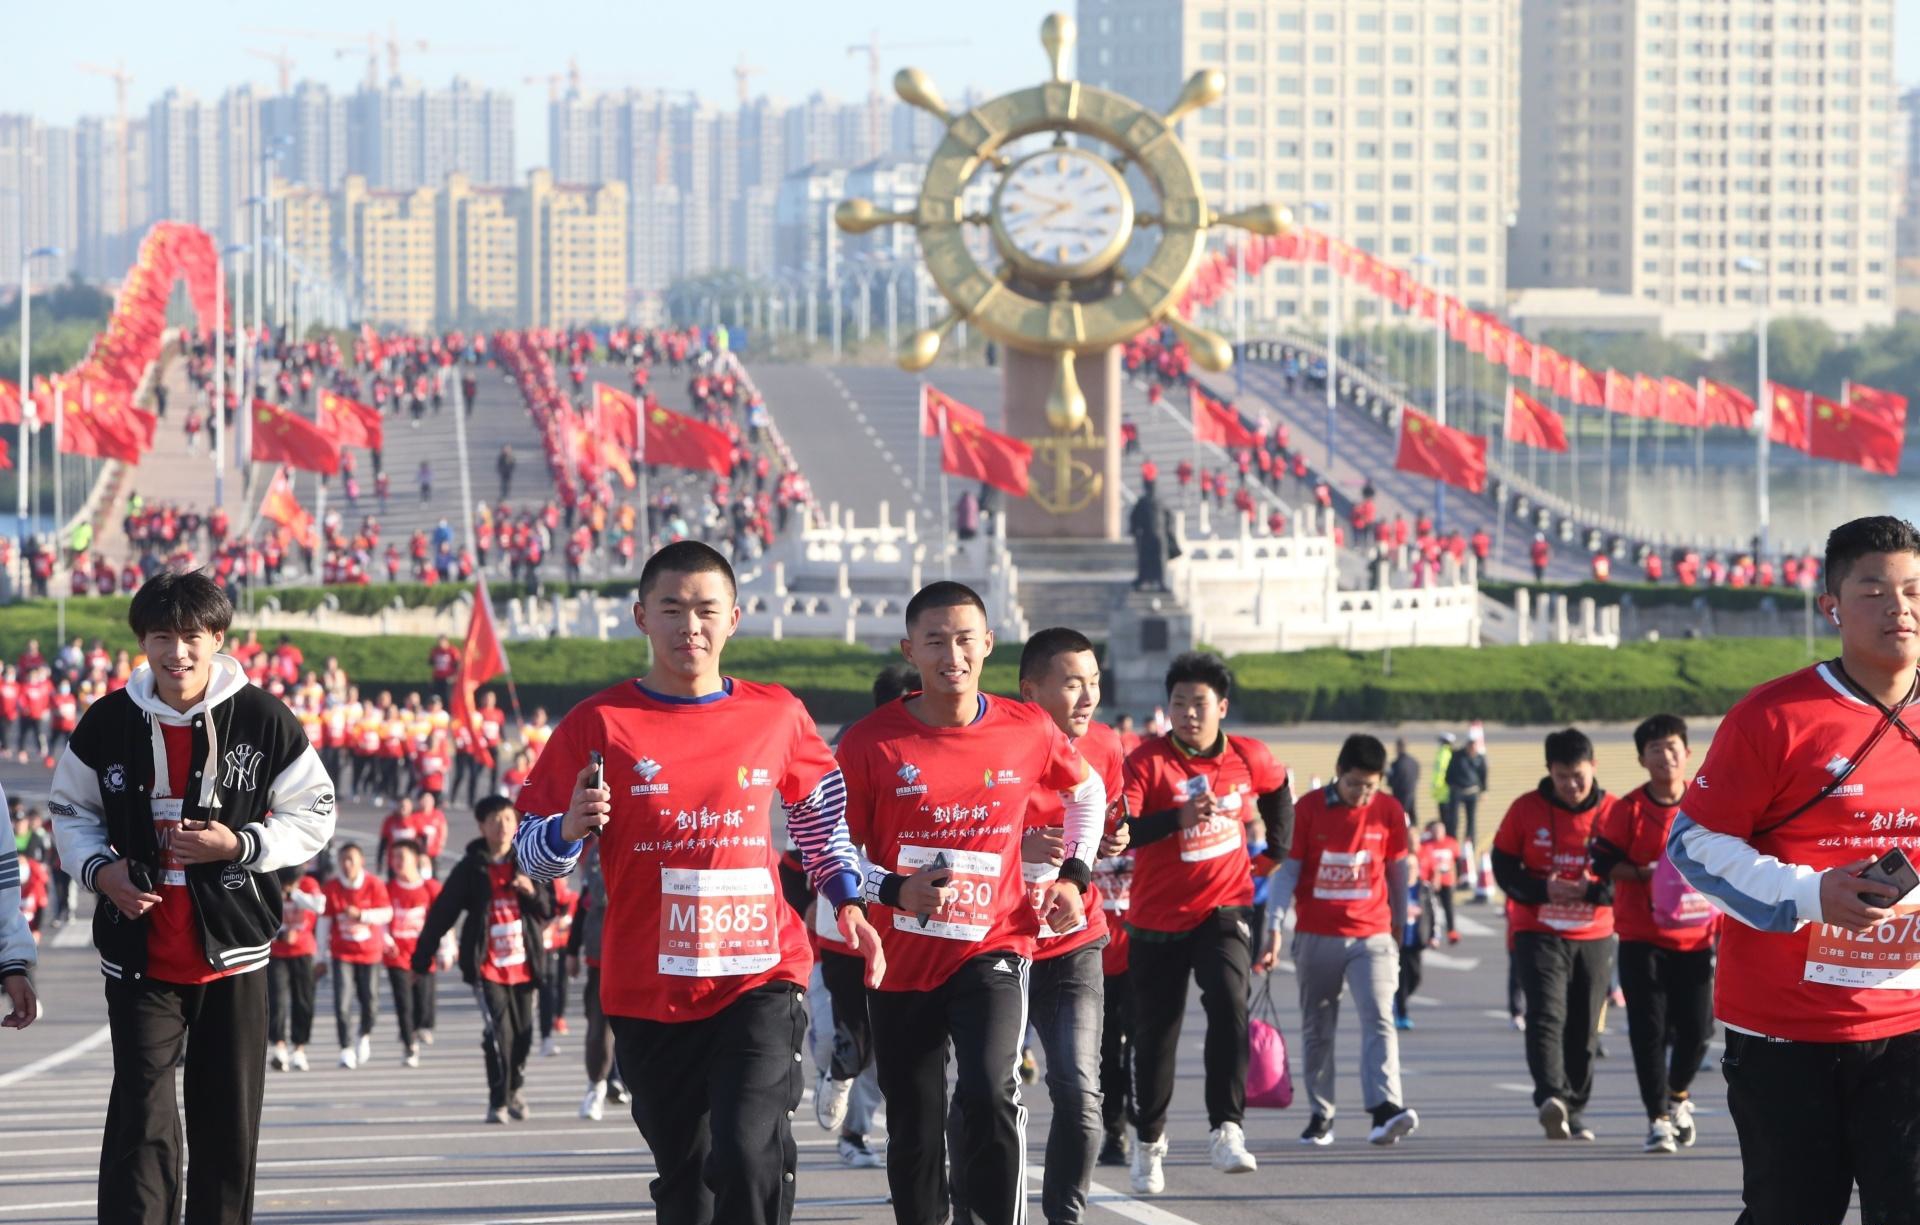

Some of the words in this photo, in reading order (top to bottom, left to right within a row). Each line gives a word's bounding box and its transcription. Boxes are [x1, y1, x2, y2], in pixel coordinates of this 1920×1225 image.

[1854, 808, 1920, 831] “创新
[946, 880, 992, 907] 630
[669, 903, 768, 934] M3685
